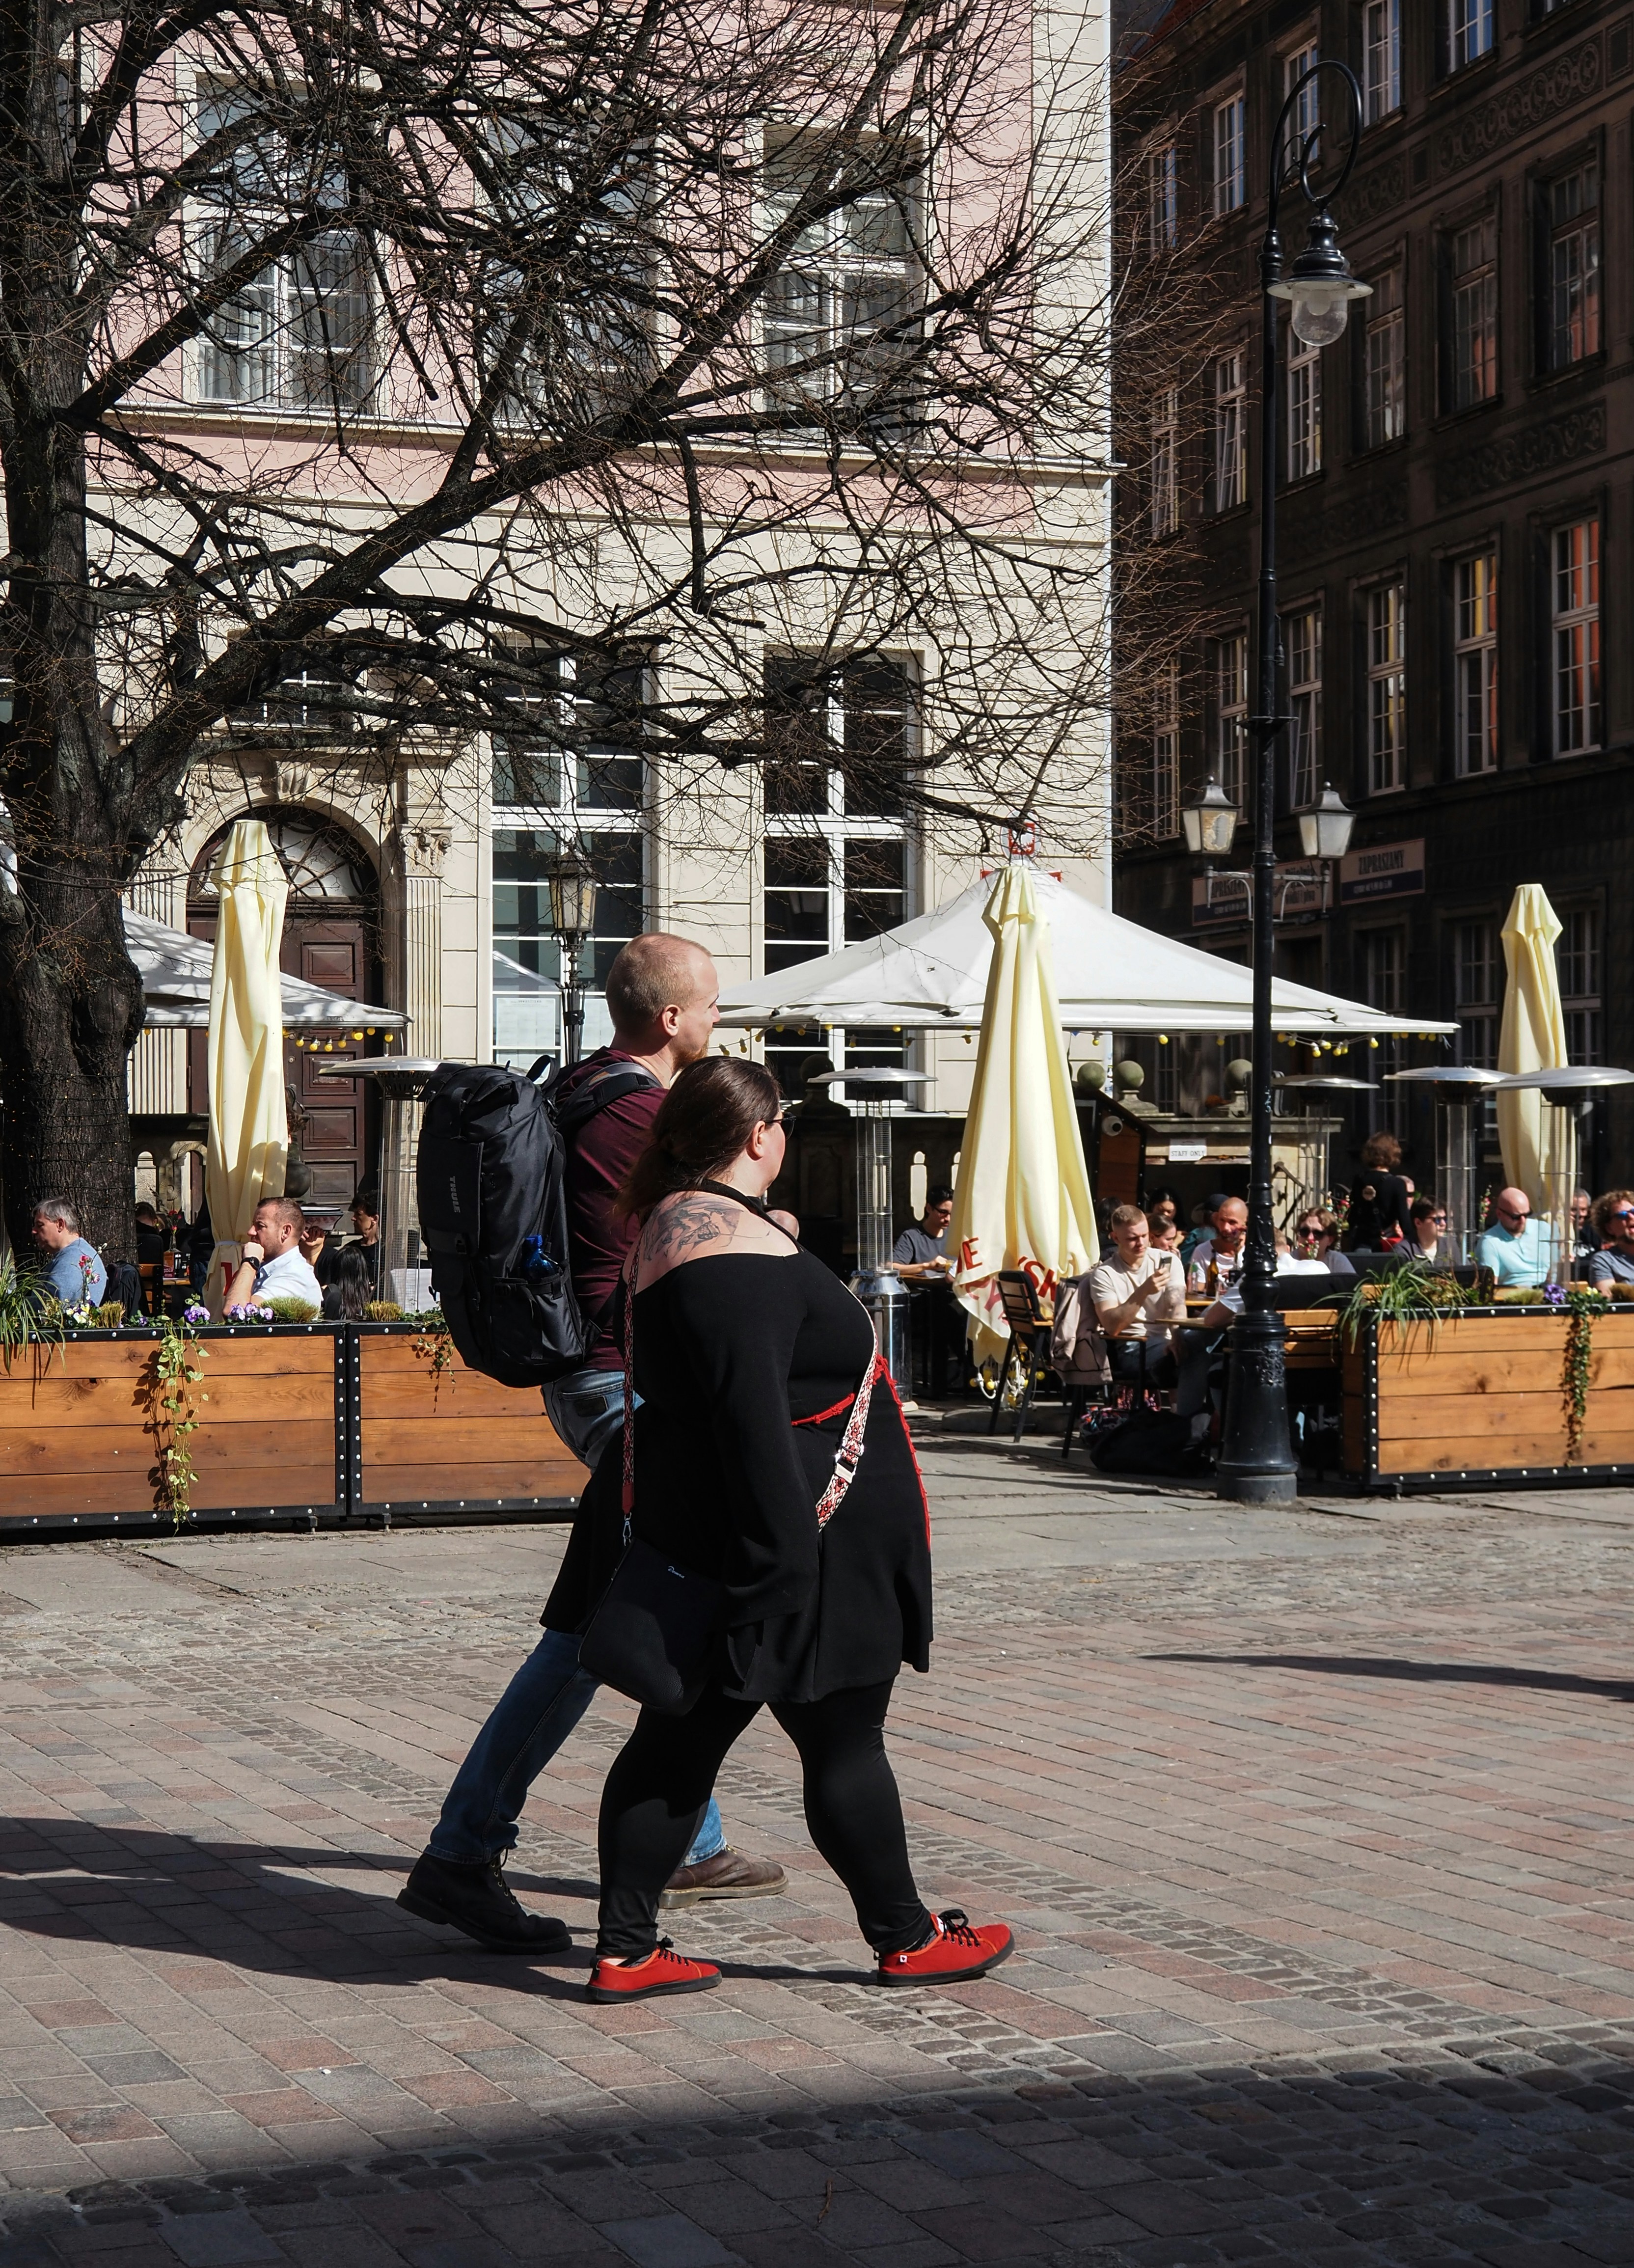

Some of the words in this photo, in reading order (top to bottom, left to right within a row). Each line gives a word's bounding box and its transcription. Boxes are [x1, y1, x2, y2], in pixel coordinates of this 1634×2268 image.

[1359, 850, 1404, 874] ZAPRASZAMY
[1210, 879, 1245, 898] APRASZAMY
[450, 1175, 461, 1213] THULE
